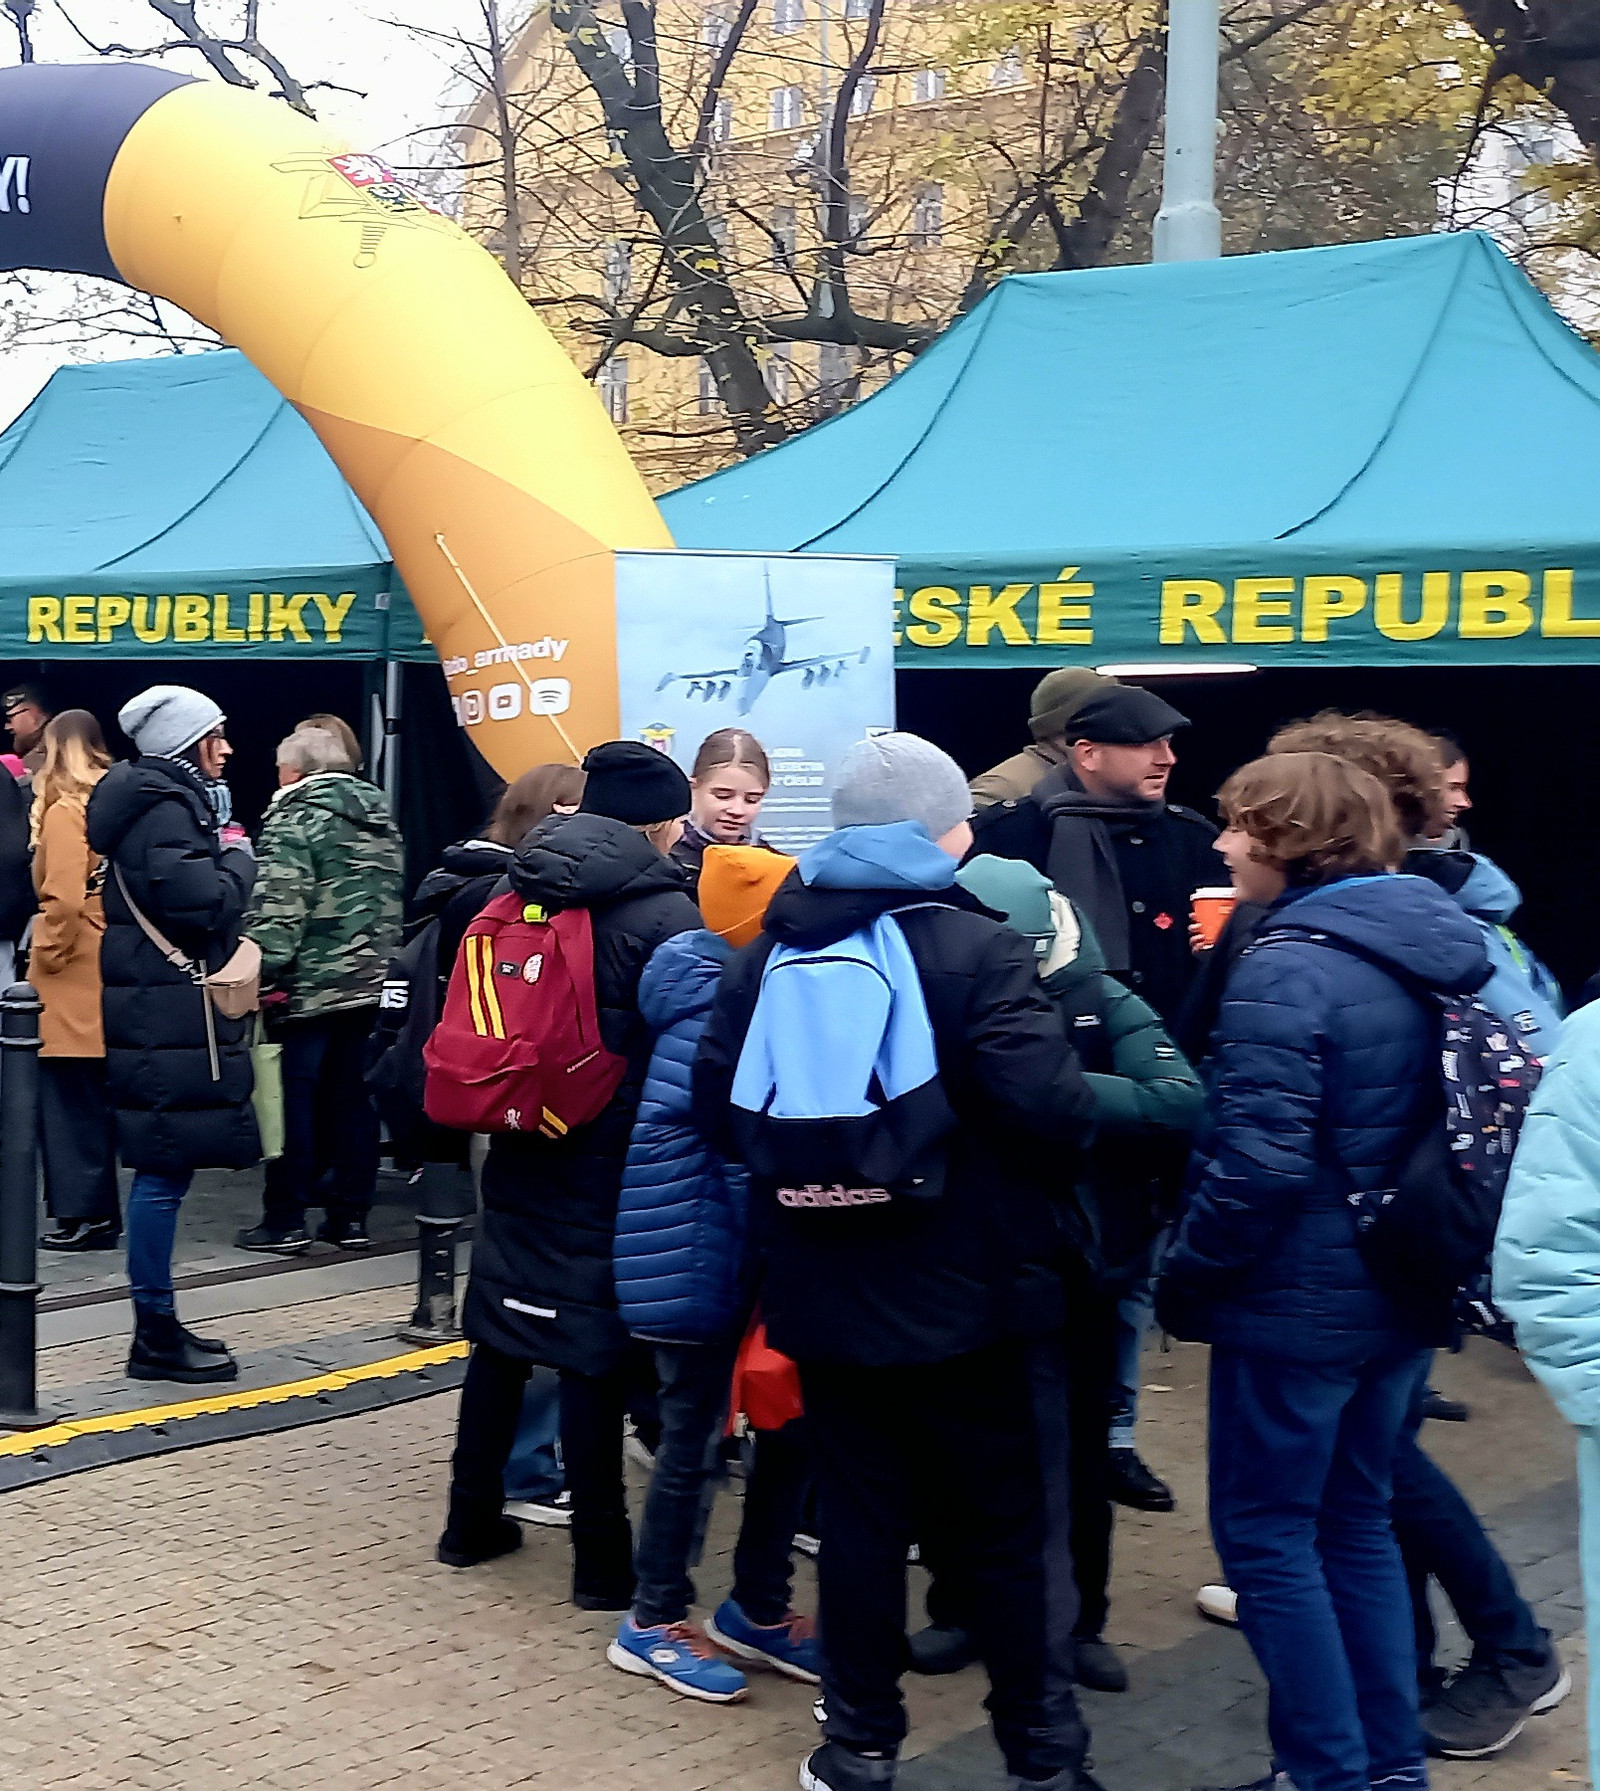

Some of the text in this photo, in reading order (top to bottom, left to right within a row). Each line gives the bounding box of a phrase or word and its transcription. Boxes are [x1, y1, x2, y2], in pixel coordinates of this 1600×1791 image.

[28, 592, 356, 644] REPUBLIKY
[891, 566, 1600, 647] SKÉ REPUBL
[776, 1184, 892, 1208] adidas
